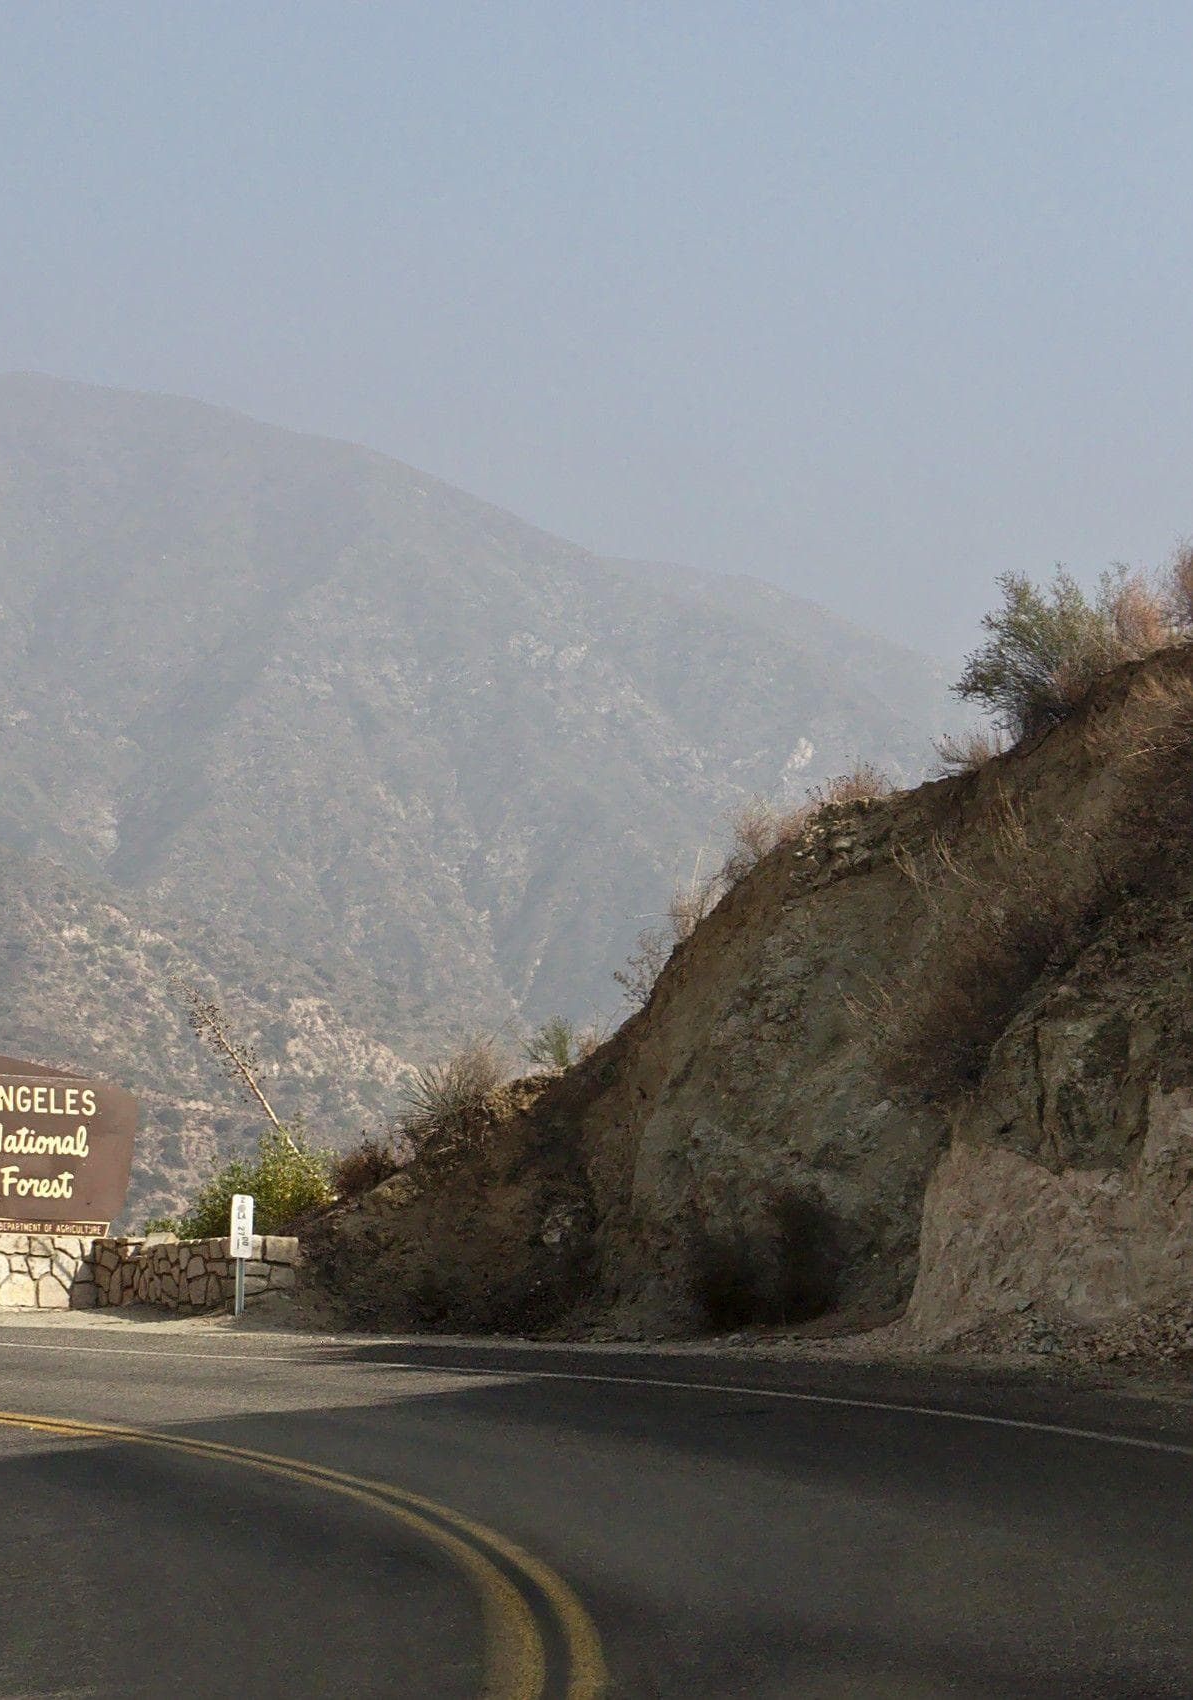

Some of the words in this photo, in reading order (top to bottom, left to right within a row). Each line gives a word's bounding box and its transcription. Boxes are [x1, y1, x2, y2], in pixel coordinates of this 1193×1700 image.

[0, 1165, 75, 1199] Forest
[44, 1223, 53, 1233] OF
[55, 1223, 102, 1235] AGRICULTURE
